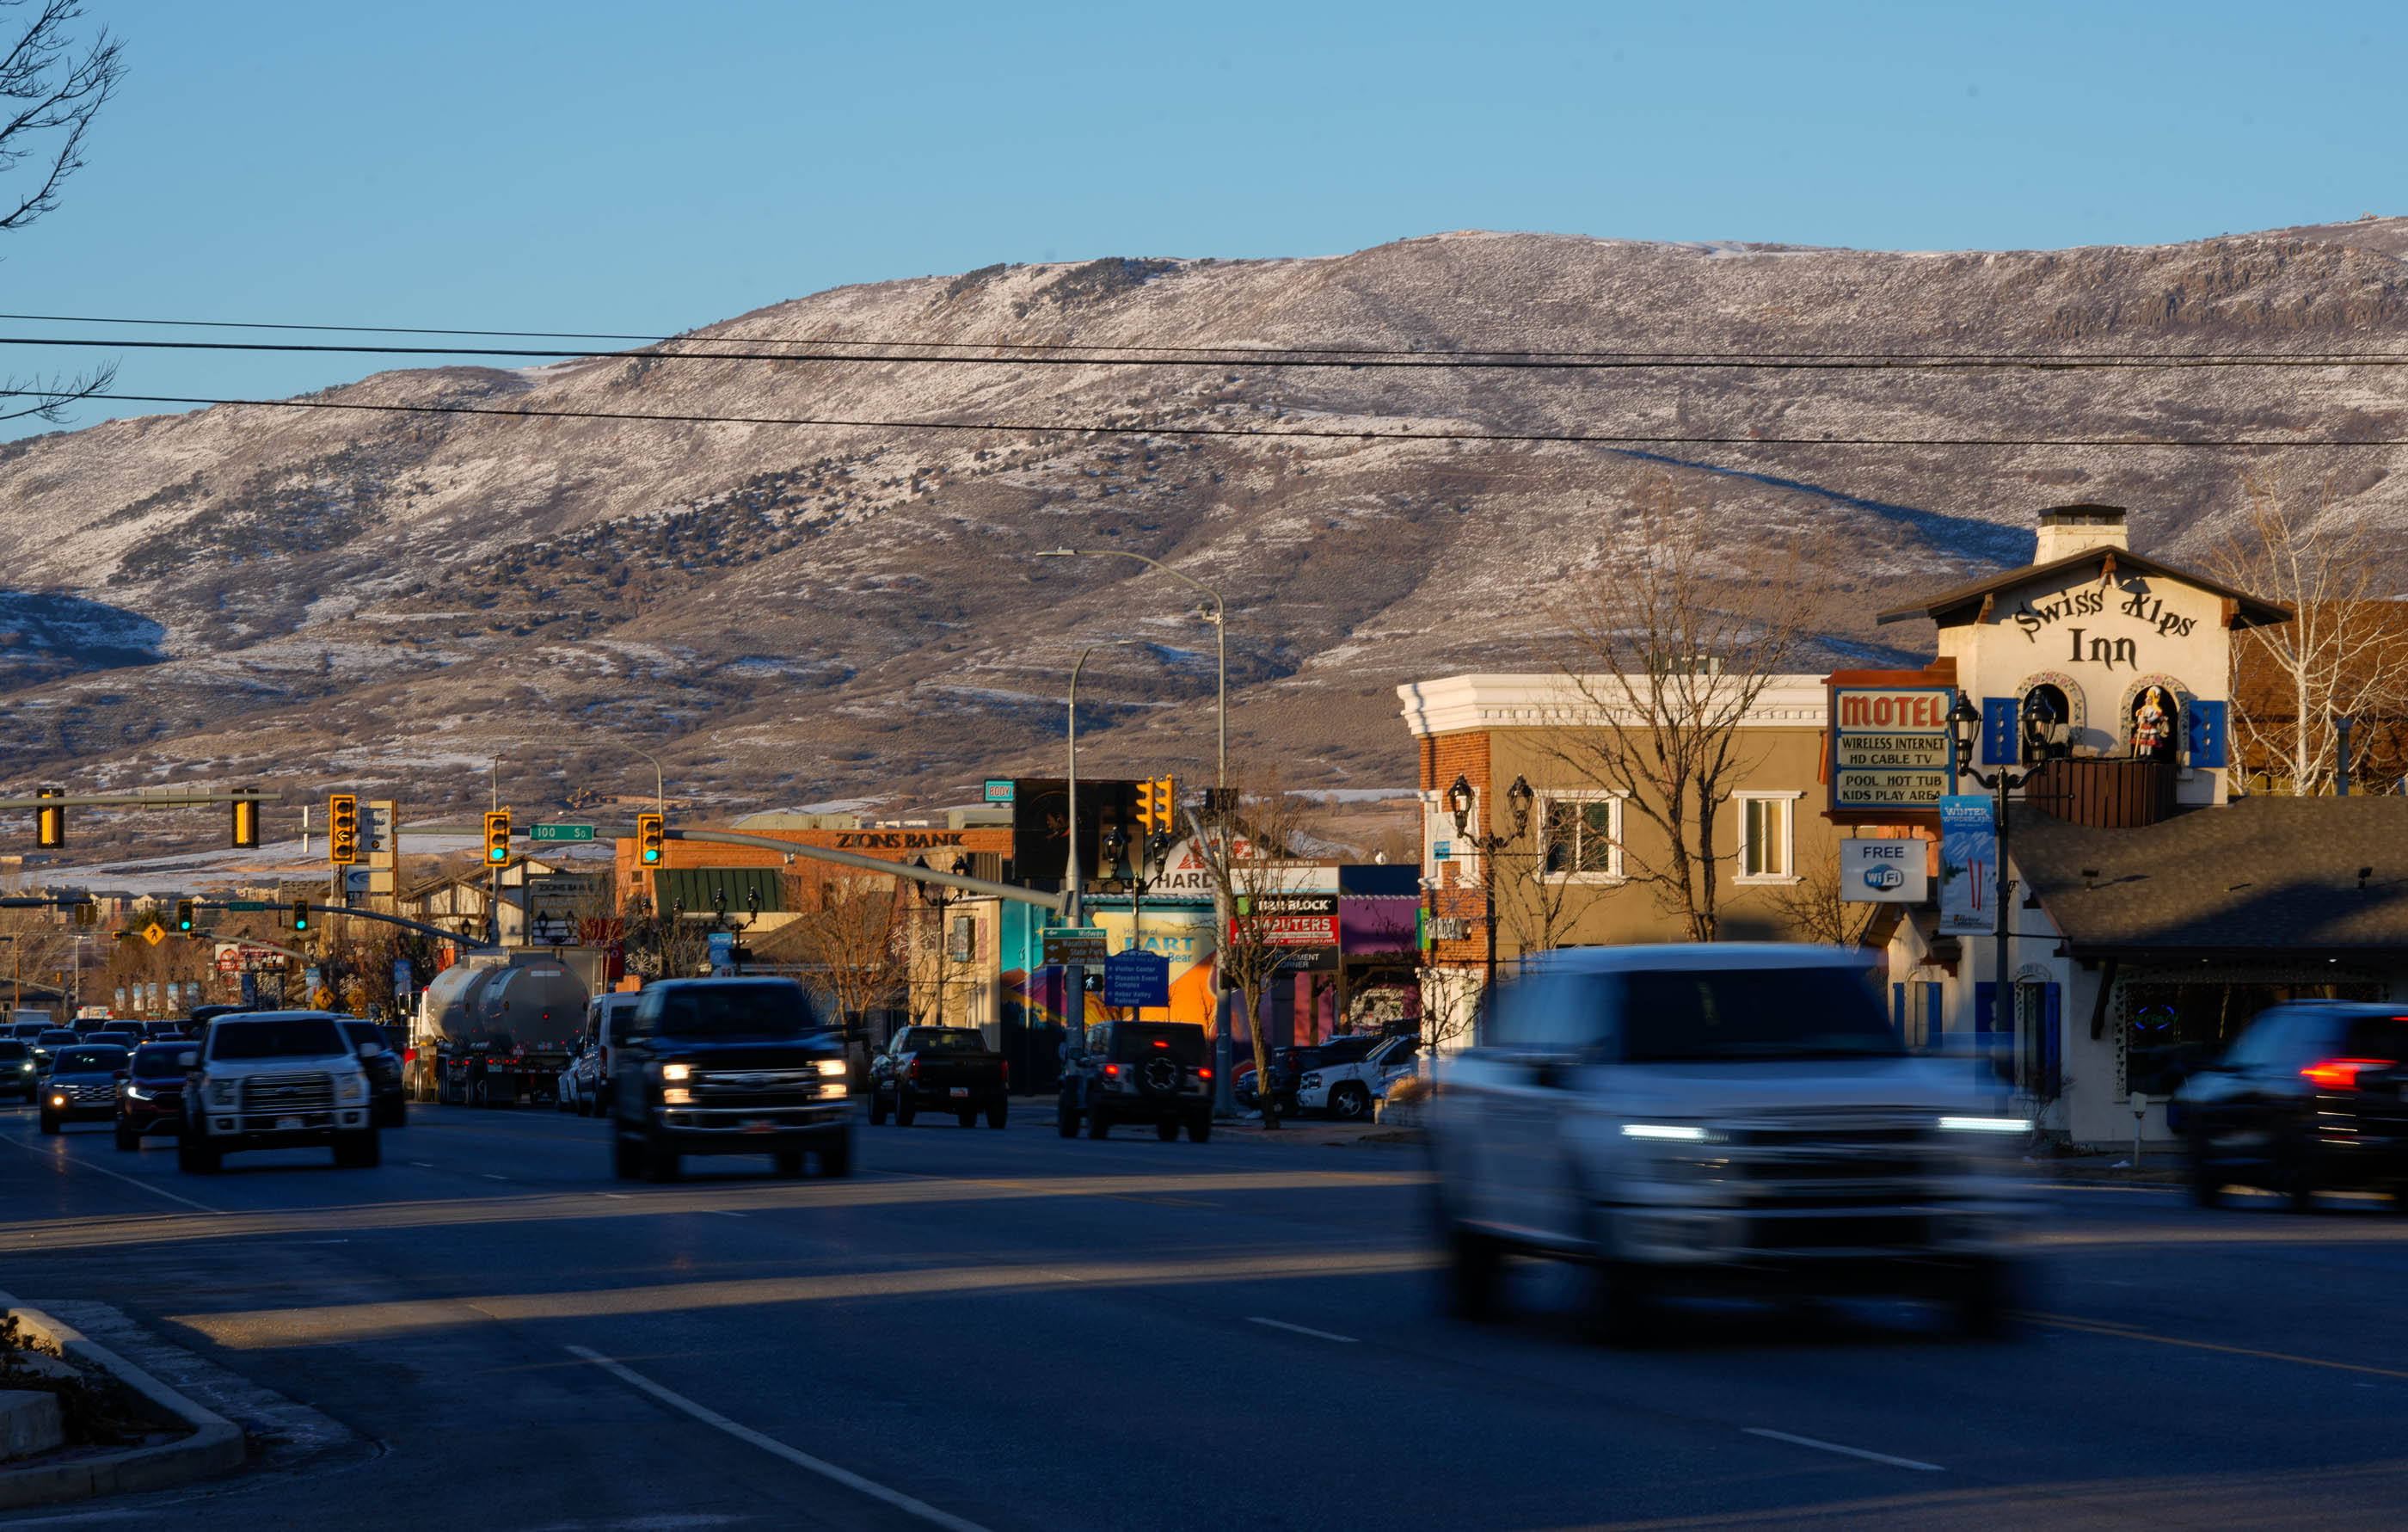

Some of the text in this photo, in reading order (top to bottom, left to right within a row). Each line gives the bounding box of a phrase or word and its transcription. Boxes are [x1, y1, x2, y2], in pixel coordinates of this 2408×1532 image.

[2015, 589, 2198, 643] Swiss Alps
[2067, 628, 2138, 671] Inn
[1841, 695, 1945, 727] MOTEL
[1842, 738, 1944, 749] WIRELESS INTERNET
[1850, 754, 1932, 765] HD CABLE TV
[1846, 776, 1943, 786] POOL HOT TUB
[989, 785, 1010, 797] BODY
[1842, 791, 1941, 801] KIDS PLAY AREA
[1944, 803, 1990, 818] WINTER
[538, 827, 556, 838] 100
[836, 833, 963, 848] ZIONS BANK
[1863, 846, 1904, 858] FREE
[1288, 900, 1330, 911] BLOCK
[1169, 952, 1193, 963] Bear
